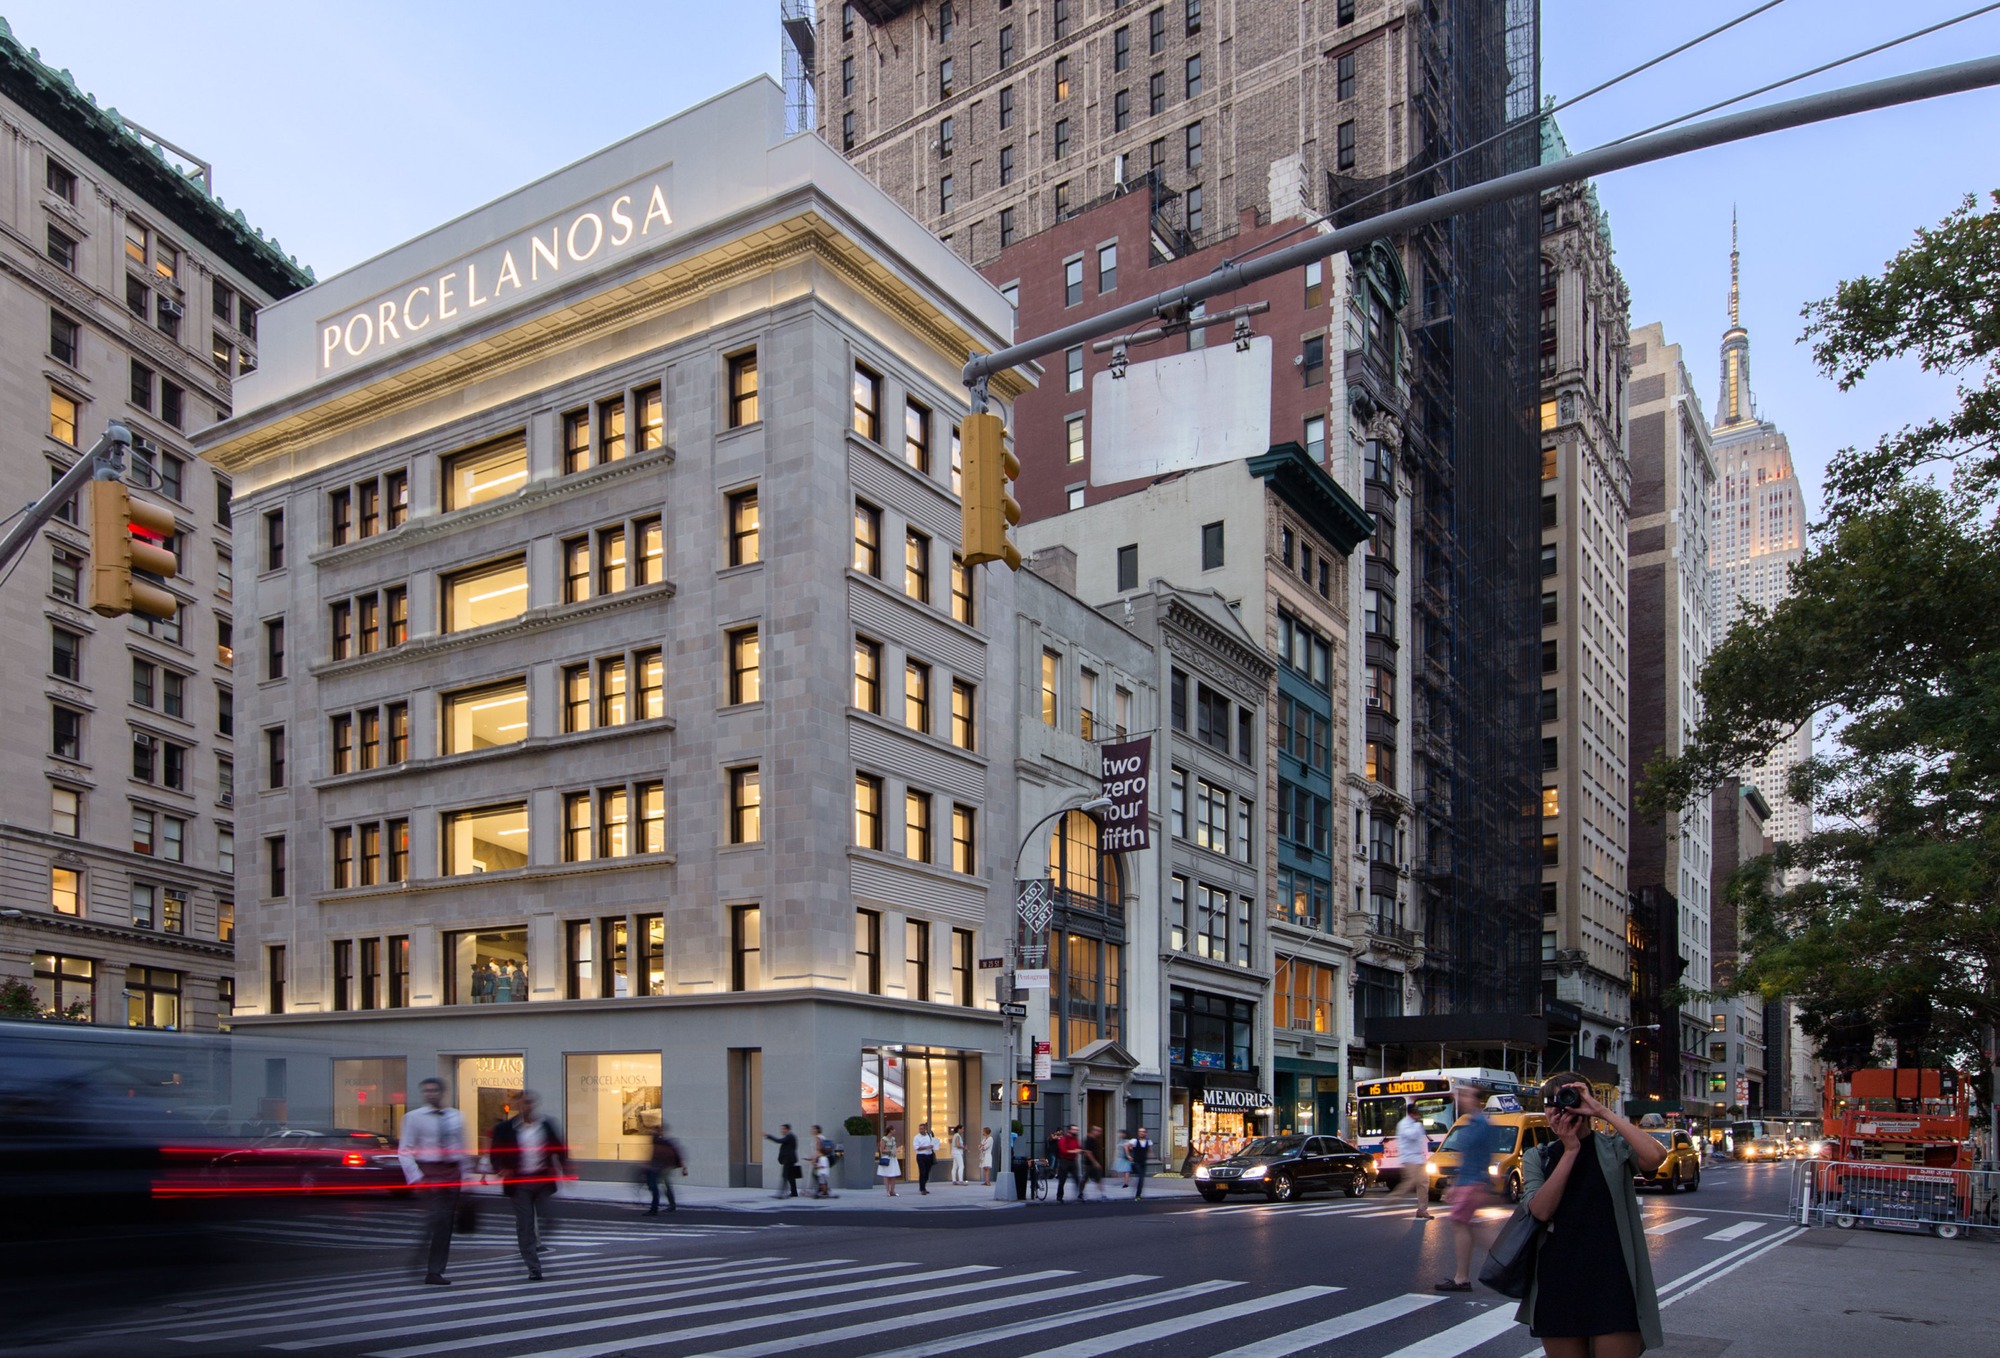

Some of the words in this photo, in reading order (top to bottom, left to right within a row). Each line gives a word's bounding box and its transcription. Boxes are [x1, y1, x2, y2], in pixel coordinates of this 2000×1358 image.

[322, 183, 673, 369] PORCELANOSA
[1102, 755, 1142, 776] two
[1102, 776, 1146, 798] zero
[1102, 824, 1145, 851] fifth
[1017, 887, 1041, 910] MAD.
[1025, 904, 1042, 919] SQ.
[1034, 906, 1053, 928] ART.
[580, 1075, 647, 1085] PORCELANOSA
[1388, 1081, 1425, 1094] LIMITED
[1203, 1089, 1274, 1108] MEMORIES
